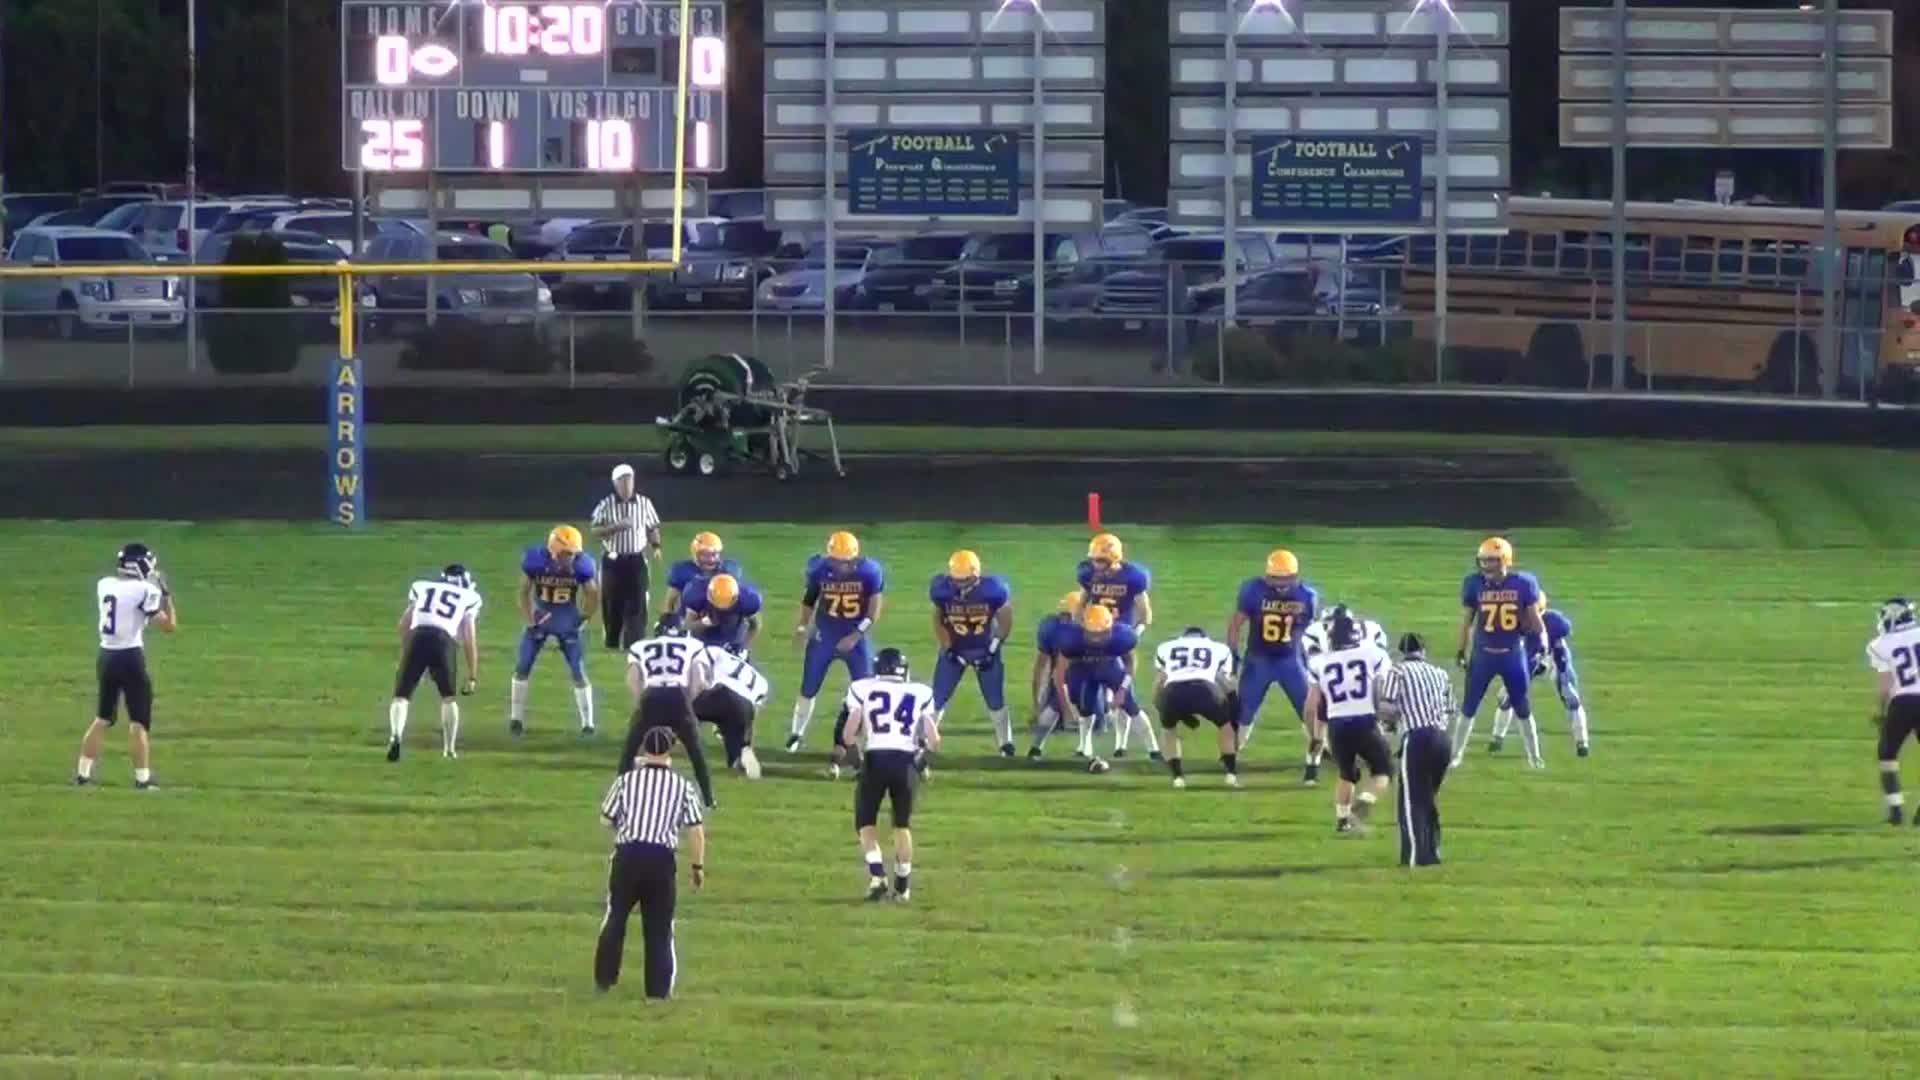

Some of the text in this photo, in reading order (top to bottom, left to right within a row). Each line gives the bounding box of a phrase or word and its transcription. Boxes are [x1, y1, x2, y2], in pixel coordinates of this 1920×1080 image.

[367, 6, 437, 35] HOME
[483, 5, 602, 55] 10:20
[615, 8, 714, 36] GUESTS
[377, 35, 408, 84] 0
[692, 36, 725, 86] 0
[404, 91, 429, 119] ON
[456, 91, 519, 119] DOWN
[549, 91, 651, 119] YDS TO GO
[361, 119, 423, 169] 25
[490, 121, 504, 168] 1
[587, 119, 632, 169] 10
[696, 121, 708, 168] 1
[892, 135, 975, 151] FOOTBALL
[1295, 142, 1377, 157] FOOTBALL
[333, 365, 358, 528] ARROWS
[101, 594, 117, 635] 3
[418, 586, 461, 619] 15
[824, 593, 861, 618] 75
[1481, 603, 1518, 633] 76
[1263, 614, 1293, 642] 61
[643, 642, 688, 677] 25
[1169, 646, 1213, 672] 59
[1323, 659, 1368, 703] 23
[867, 689, 917, 736] 24
